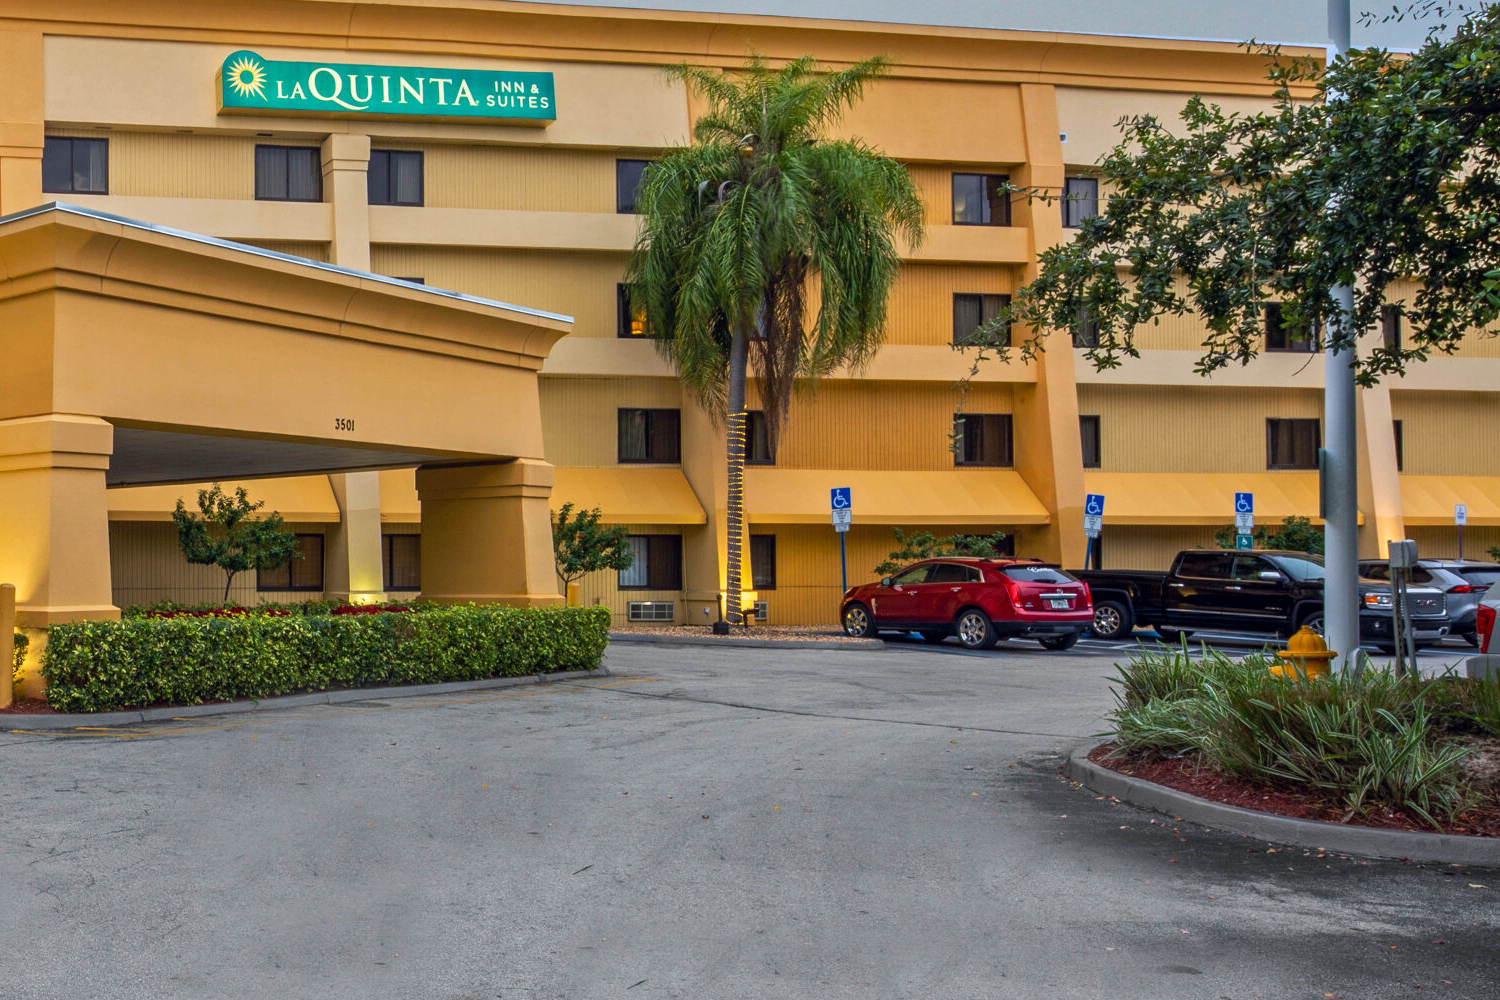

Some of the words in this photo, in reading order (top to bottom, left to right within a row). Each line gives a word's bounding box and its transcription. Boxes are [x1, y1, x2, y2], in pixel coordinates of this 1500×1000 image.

[276, 80, 307, 100] LA
[308, 67, 479, 110] QUINTA
[495, 81, 525, 93] INN
[530, 84, 539, 94] &
[486, 95, 549, 109] SUITES
[335, 418, 355, 431] 3501
